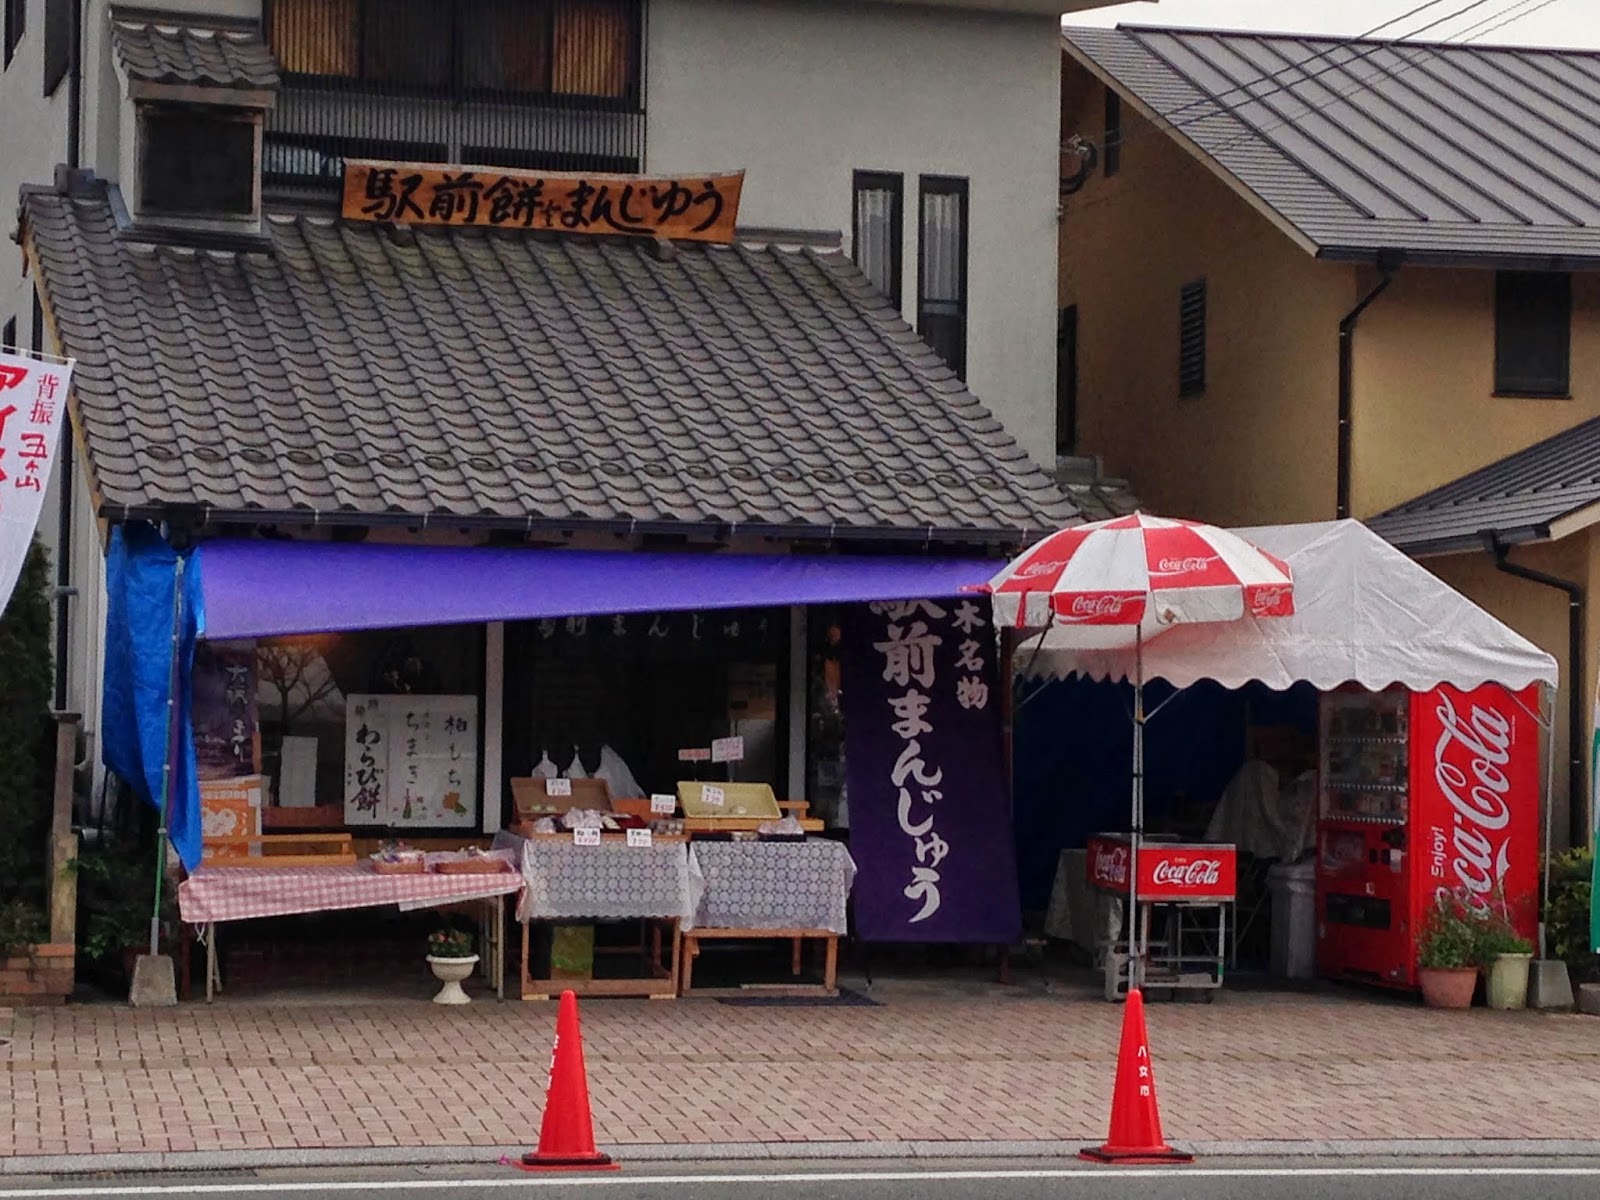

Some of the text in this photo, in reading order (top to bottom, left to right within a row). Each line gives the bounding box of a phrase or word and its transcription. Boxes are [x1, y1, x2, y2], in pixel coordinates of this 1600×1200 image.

[350, 723, 384, 819] わらび餅
[1153, 860, 1221, 885] Coca-Cola
[1430, 825, 1447, 878] Enjoy!
[1137, 1045, 1150, 1097] 八女市
